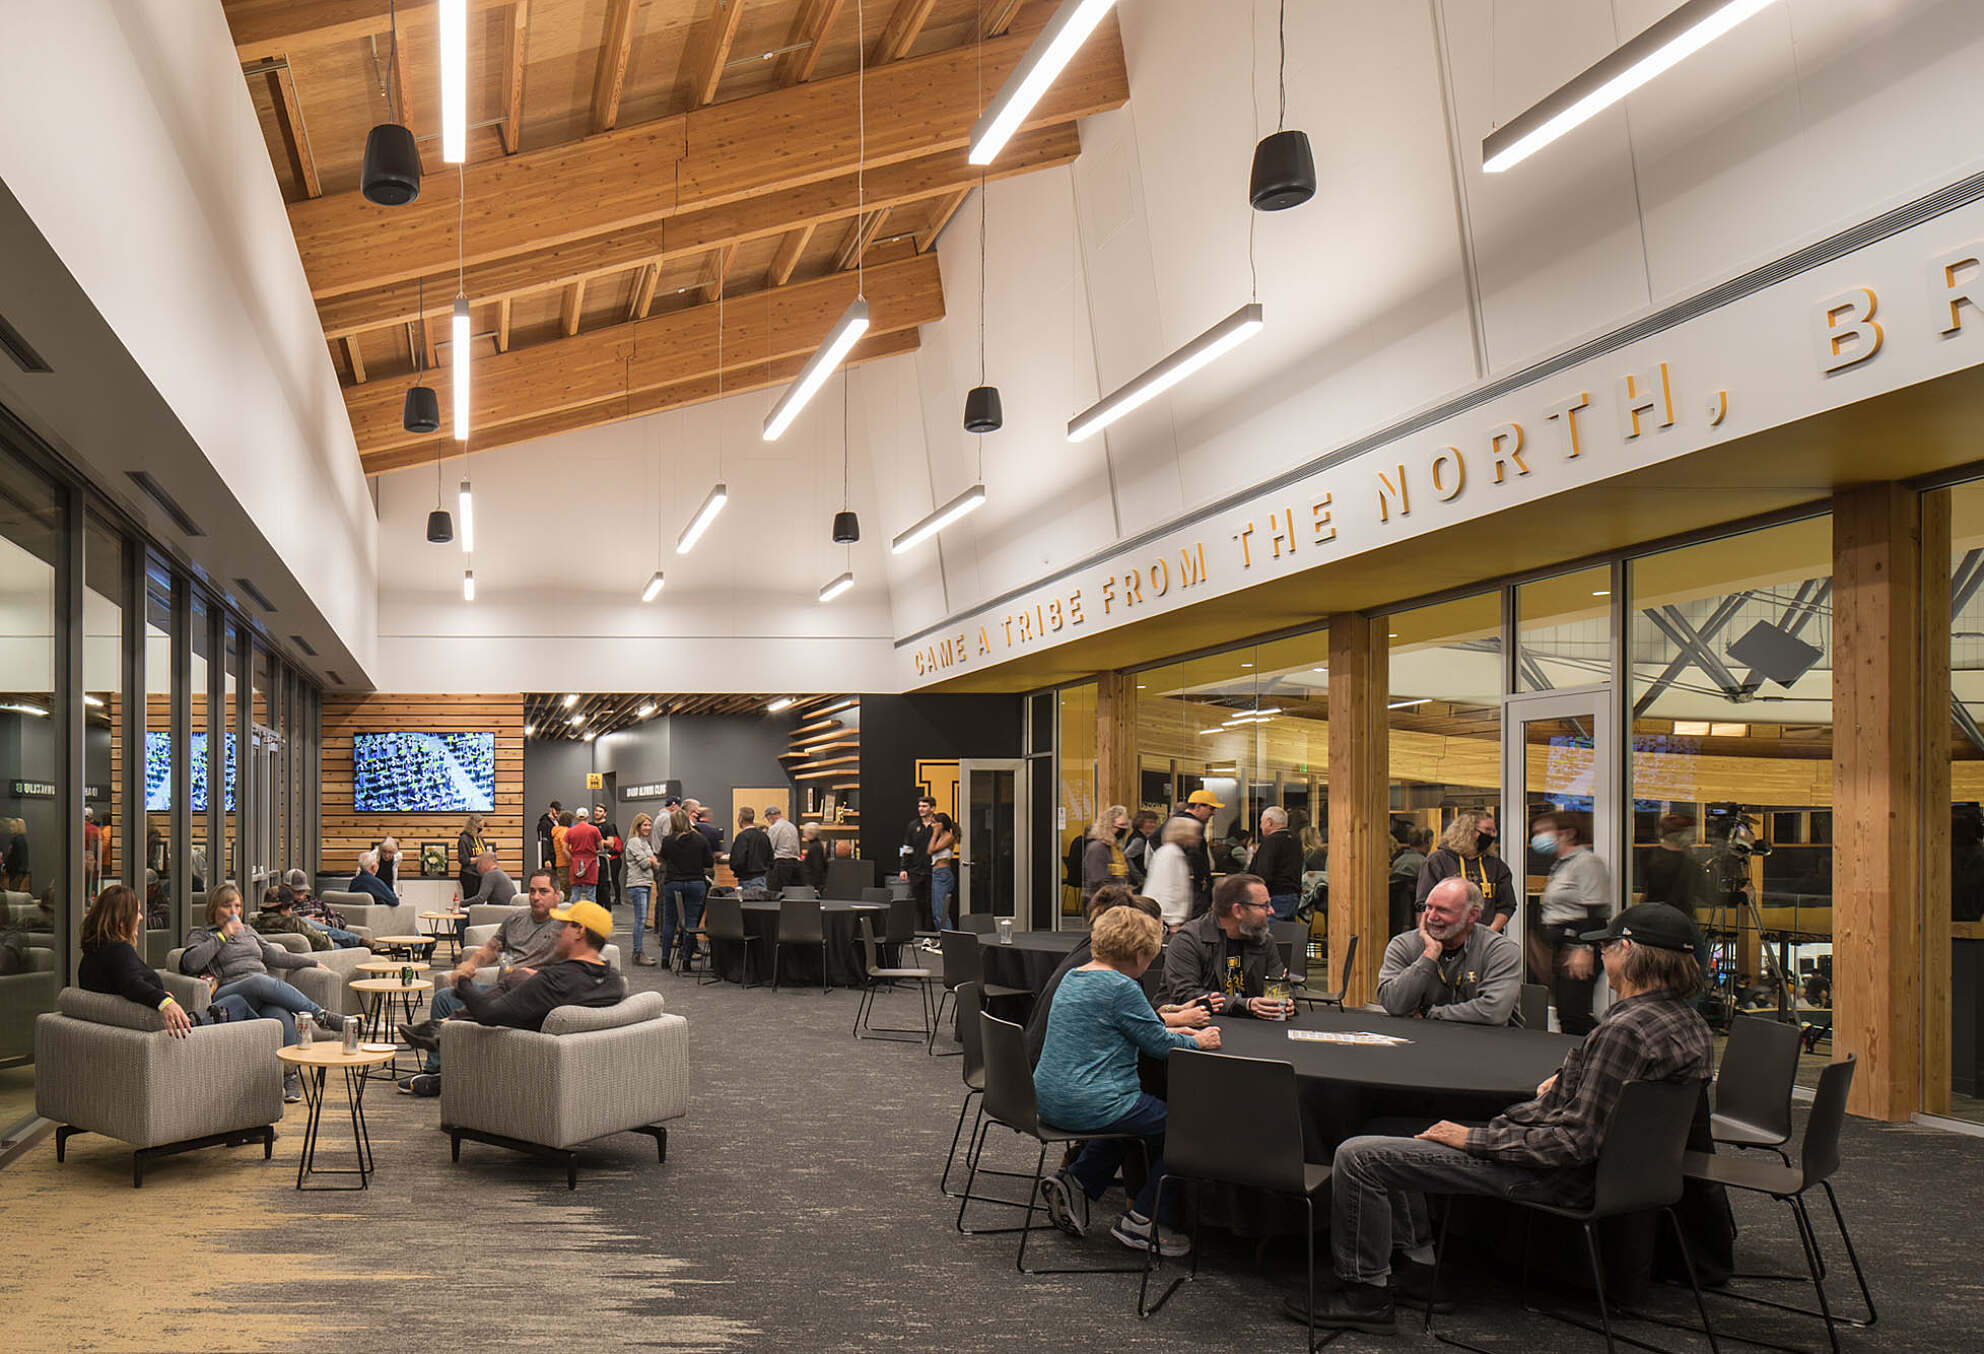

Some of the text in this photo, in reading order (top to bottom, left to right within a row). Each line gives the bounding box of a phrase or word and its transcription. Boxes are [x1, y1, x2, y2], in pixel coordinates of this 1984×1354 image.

[914, 634, 967, 676] CAME
[977, 625, 990, 656] A
[1001, 589, 1084, 647] TRIBE
[1101, 541, 1207, 614] FROM
[1232, 492, 1337, 567] THE
[1375, 362, 1729, 523] NORTH,
